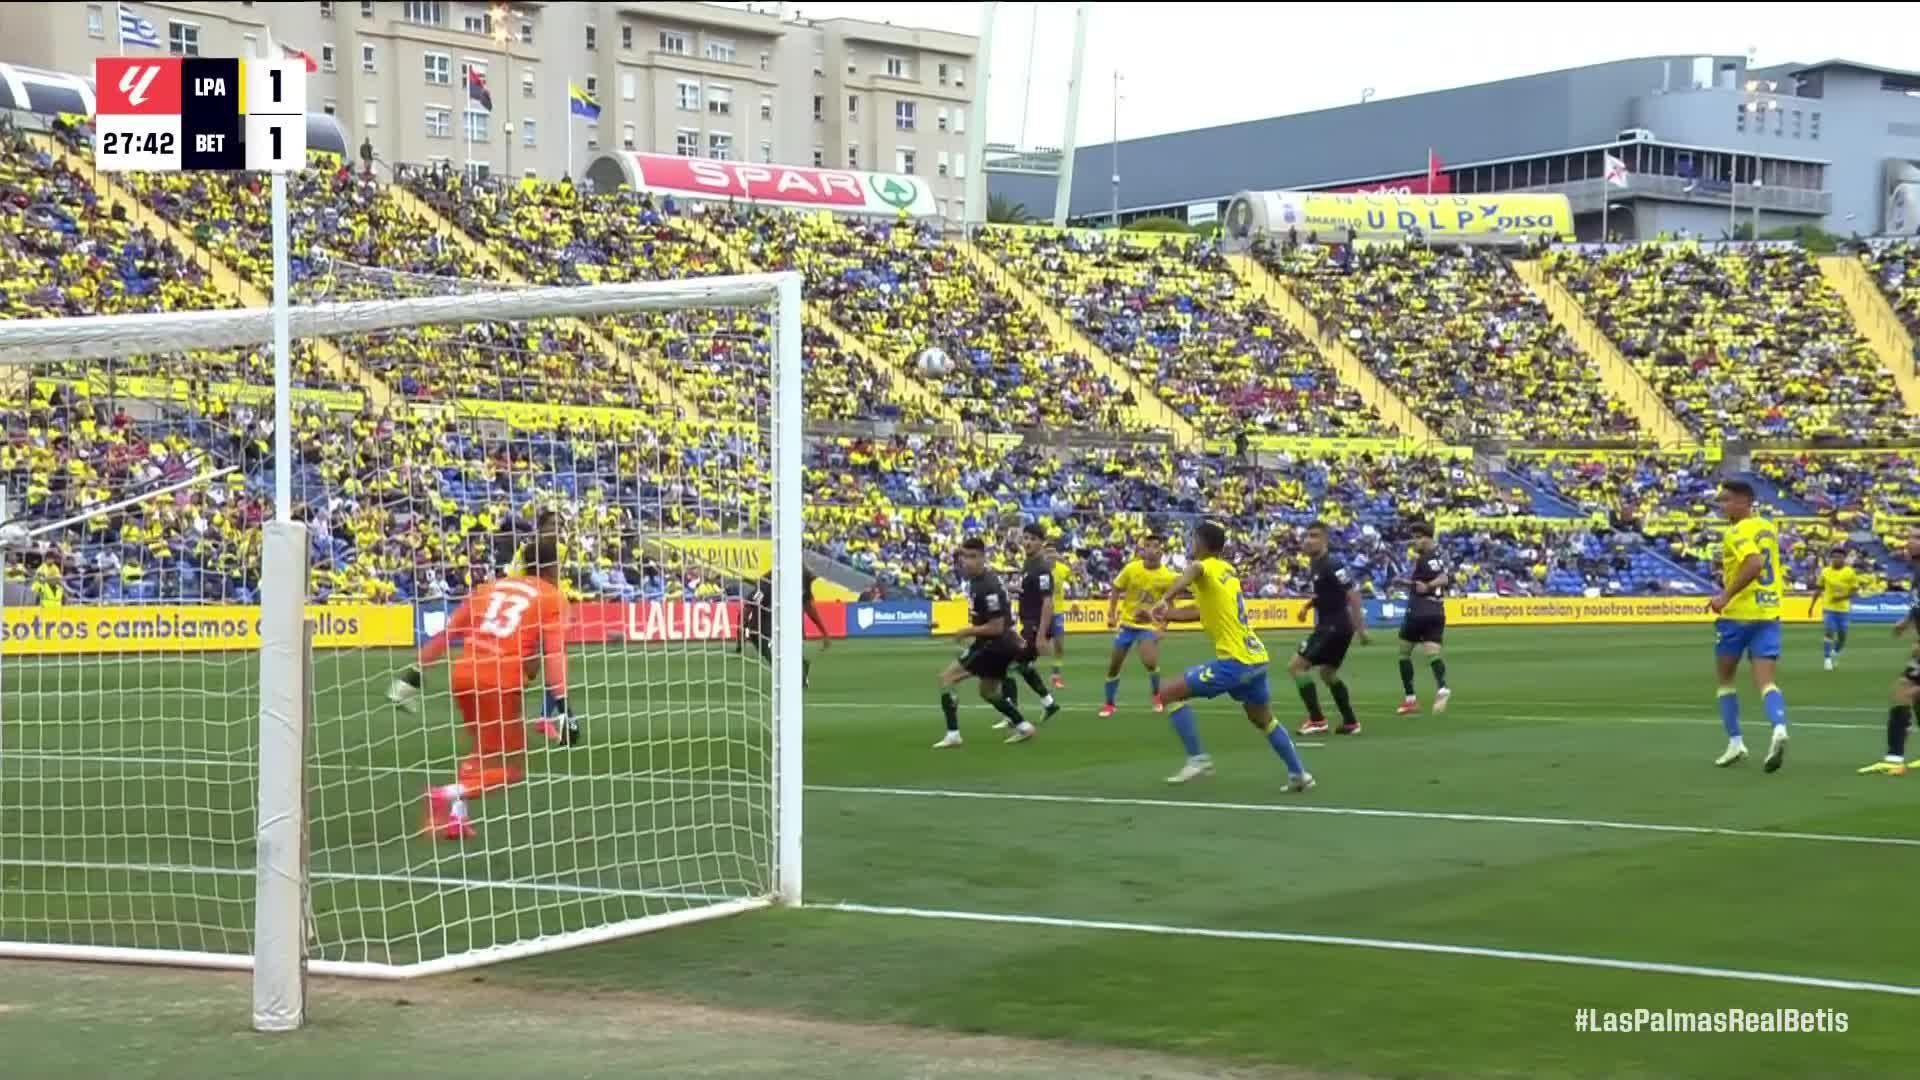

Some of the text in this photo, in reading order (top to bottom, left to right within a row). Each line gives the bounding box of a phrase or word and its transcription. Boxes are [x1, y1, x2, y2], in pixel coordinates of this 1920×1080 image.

[688, 161, 863, 198] SPAR
[96, 612, 249, 639] cambiamos
[479, 591, 531, 639] 13
[628, 601, 732, 640] LALIGA
[1460, 603, 1479, 618] Los
[1480, 603, 1524, 619] tiempos
[1526, 603, 1574, 617] cambian
[1575, 606, 1583, 619] y
[1583, 604, 1634, 617] nosotros
